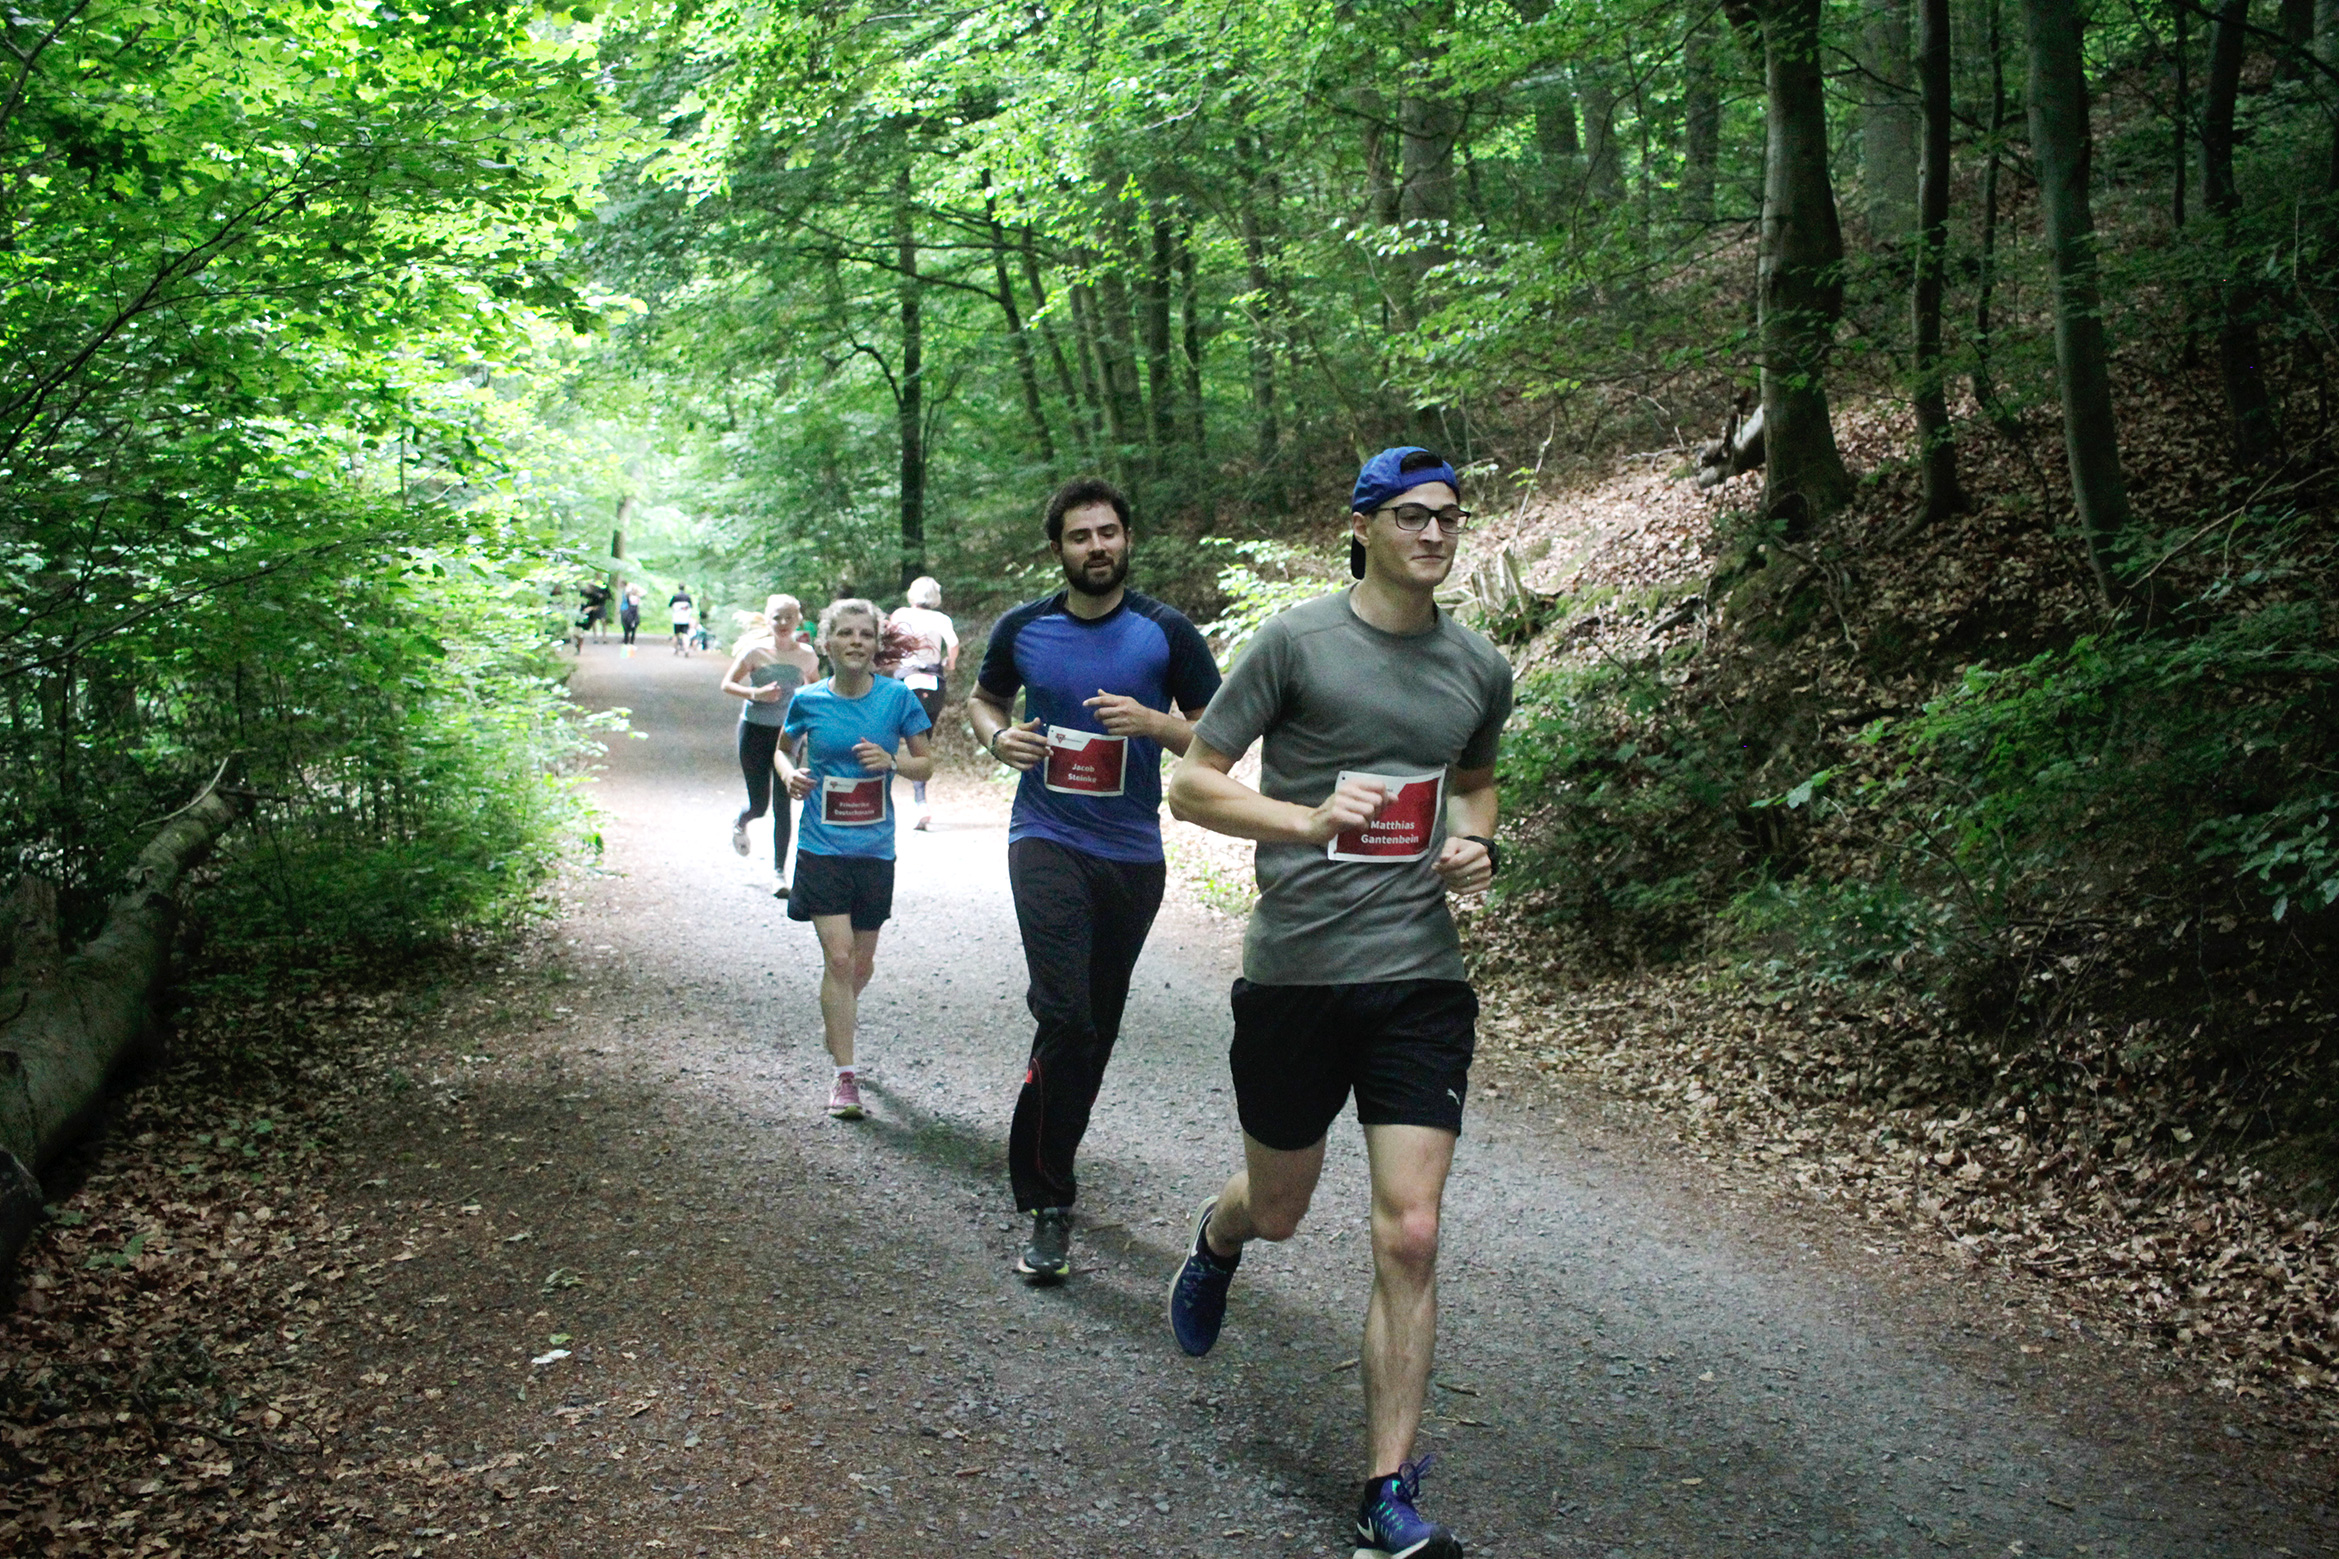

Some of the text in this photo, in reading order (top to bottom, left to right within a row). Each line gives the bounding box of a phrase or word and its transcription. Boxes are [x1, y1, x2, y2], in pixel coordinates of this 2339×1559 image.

[1072, 763, 1095, 772] Jacob
[1370, 820, 1415, 830] Matthias
[1361, 834, 1419, 844] Gantenbein
